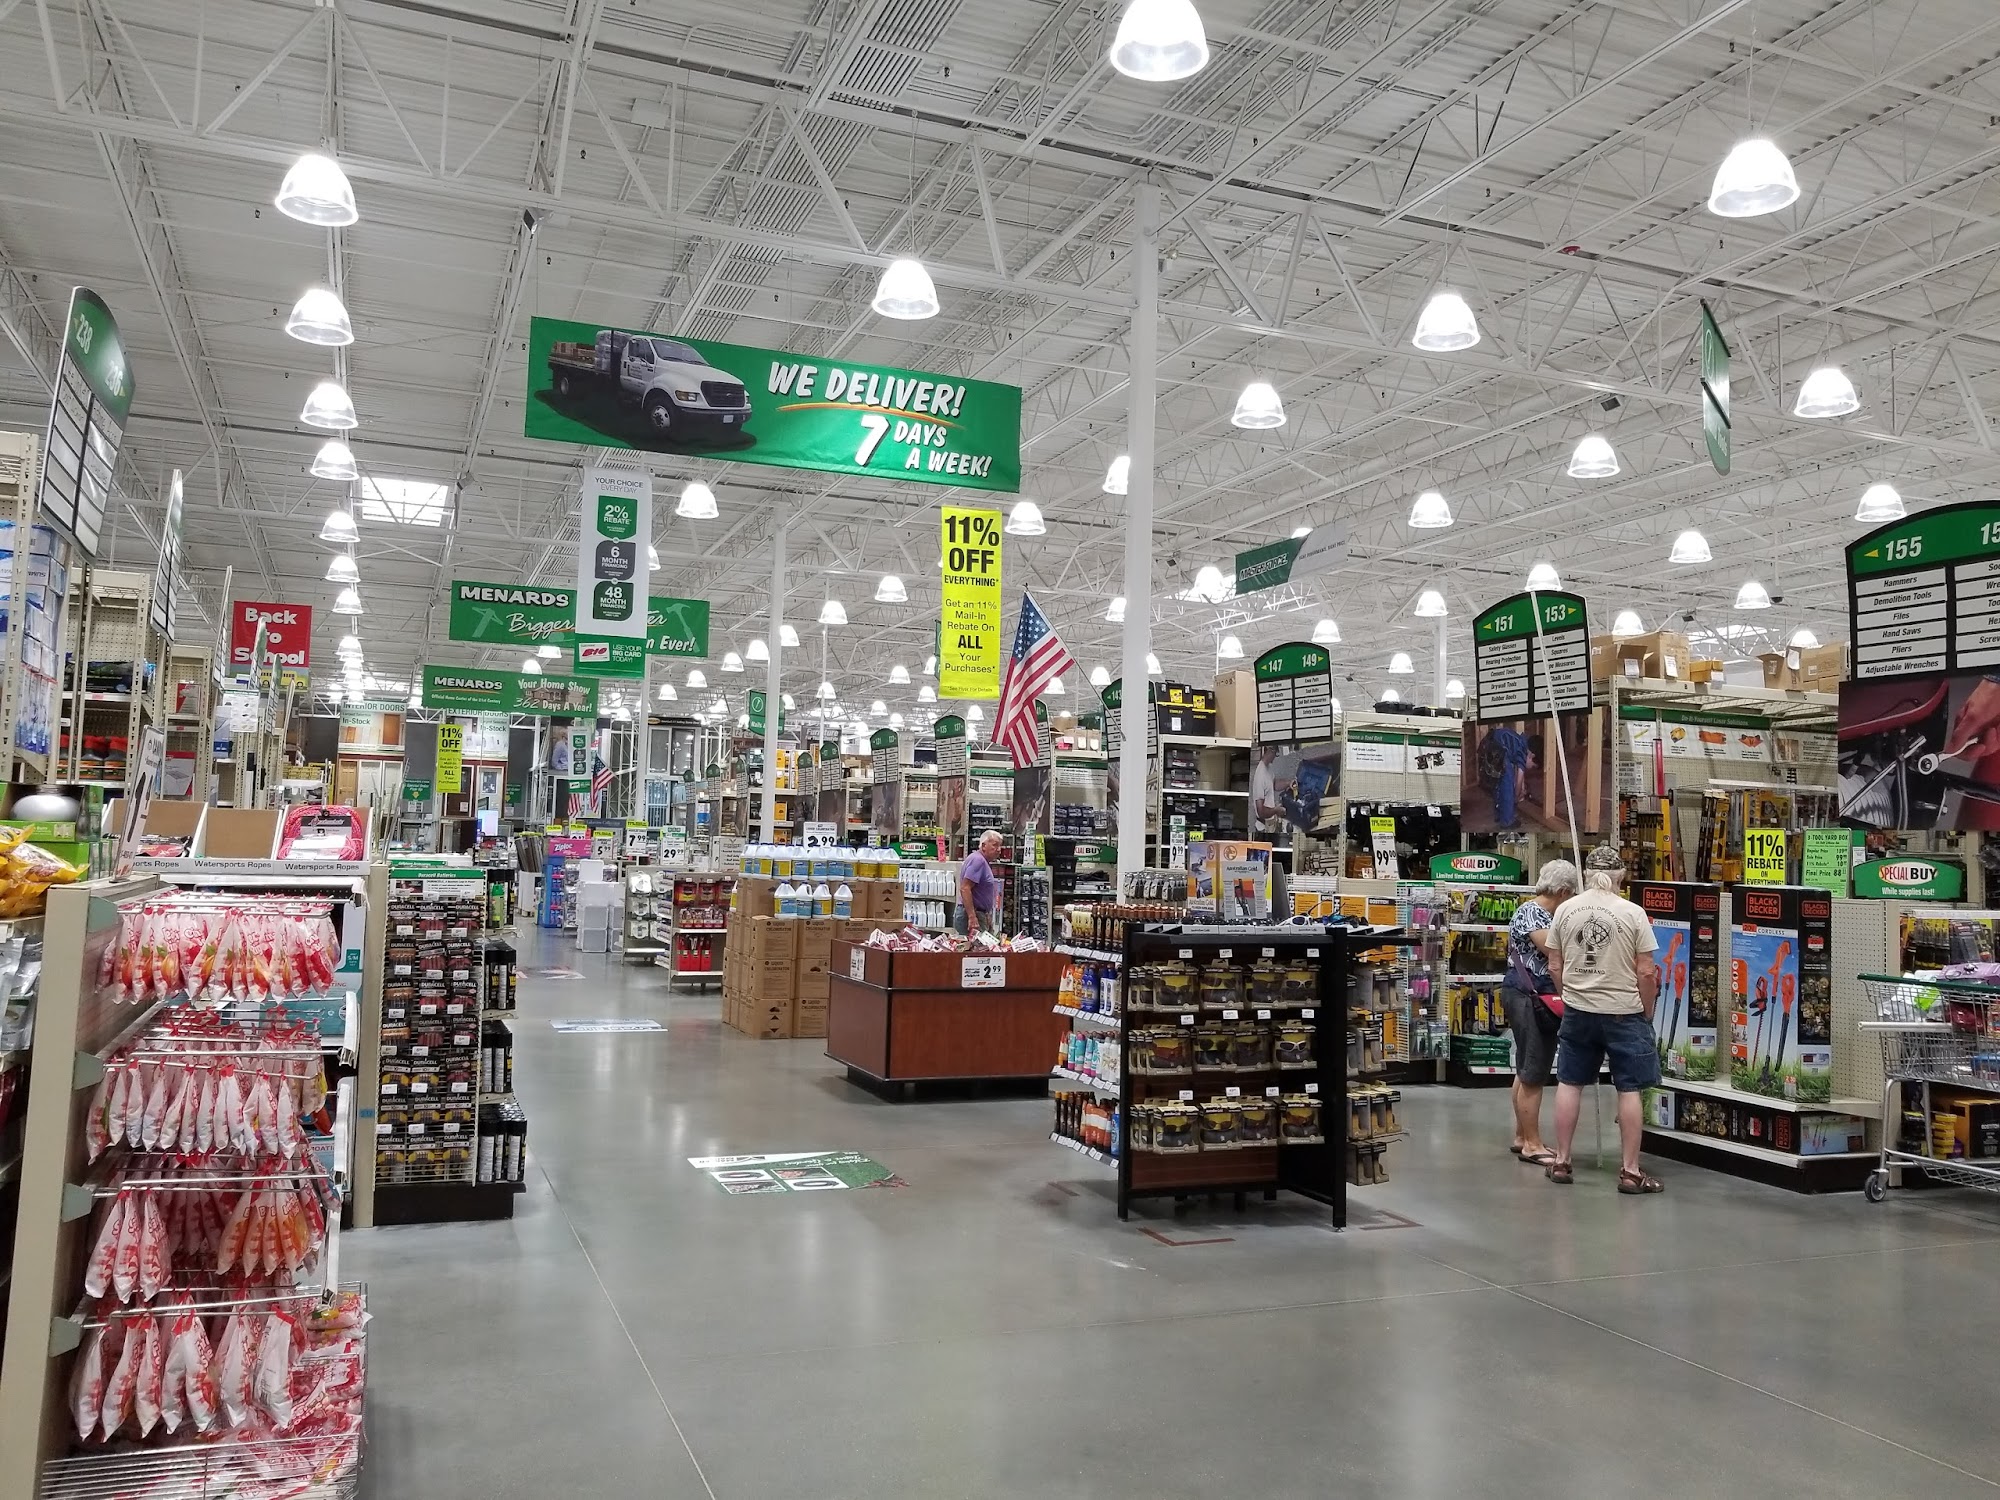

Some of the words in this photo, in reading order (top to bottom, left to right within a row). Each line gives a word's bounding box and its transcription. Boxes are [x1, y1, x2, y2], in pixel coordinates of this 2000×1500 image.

[76, 313, 93, 354] 238
[767, 361, 816, 398] WE
[824, 369, 968, 418] DELIVER!
[893, 421, 947, 448] DAYS
[854, 414, 891, 468] 7
[904, 447, 920, 470] A
[925, 450, 993, 479] WEEK!
[595, 477, 615, 485] YOUR
[617, 480, 644, 488] CHOICE
[601, 484, 622, 492] EVERY
[624, 486, 637, 494] DAY
[605, 505, 629, 518] 2%
[945, 515, 1000, 547] 11%
[1981, 522, 2000, 545] 15
[611, 547, 620, 557] 6
[1885, 536, 1922, 561] 155
[949, 548, 995, 573] OFF
[1884, 576, 1917, 587] Hammers
[460, 586, 569, 608] MENARDS
[605, 587, 622, 598] 48
[1874, 594, 1911, 606] Demolition
[1914, 591, 1932, 600] Tools
[946, 599, 961, 608] Get
[245, 608, 297, 625] Back
[955, 611, 986, 620] Mail-In
[1545, 604, 1566, 623] 153
[1893, 612, 1909, 620] Files
[506, 612, 575, 640] Bigger
[948, 622, 979, 631] Rebate
[1494, 615, 1513, 632] 151
[1883, 629, 1900, 638] Hand
[1902, 626, 1921, 635] Saws
[660, 636, 696, 652] Ever!
[958, 635, 983, 649] ALL
[1892, 645, 1912, 653] Pliers
[960, 653, 981, 661] Your
[1302, 653, 1317, 667] 149
[1486, 658, 1500, 666] Hearing
[1269, 659, 1282, 672] 147
[1865, 663, 1902, 675] Adjustable
[1904, 660, 1938, 669] Wrenches
[434, 676, 502, 690] MENARDS
[518, 679, 537, 689] Your
[541, 678, 564, 690] Home
[568, 681, 591, 694] Show
[380, 704, 405, 712] DOORS
[513, 697, 539, 709] 362
[542, 700, 561, 711] Days
[564, 702, 570, 710] A
[572, 702, 592, 712] Year!
[440, 728, 463, 738] 11%
[806, 728, 839, 737] Furnture
[442, 739, 460, 748] OFF
[629, 835, 636, 846] 7
[1747, 834, 1783, 857] 11%
[598, 847, 602, 855] 5
[664, 849, 676, 859] 29
[1172, 846, 1177, 861] 9
[1376, 850, 1389, 866] 99
[1452, 858, 1475, 869] SPECIAL
[1477, 860, 1500, 869] BUY
[1747, 858, 1784, 870] REBATE
[195, 861, 245, 869] Watersports
[246, 861, 271, 869] Ropes
[285, 863, 335, 871] Watersports
[337, 863, 359, 871] Ropes
[1879, 866, 1909, 881] SPECIAL
[1910, 868, 1938, 880] BUY
[1646, 892, 1673, 900] BLACK+
[1882, 887, 1898, 895] While
[1899, 888, 1921, 896] supplies
[1922, 887, 1935, 896] last!
[1645, 900, 1673, 908] DECKER
[1749, 898, 1777, 906] BLACK+
[1571, 905, 1595, 916] SPECIAL
[1749, 906, 1778, 915] DECKER
[984, 965, 991, 979] 2
